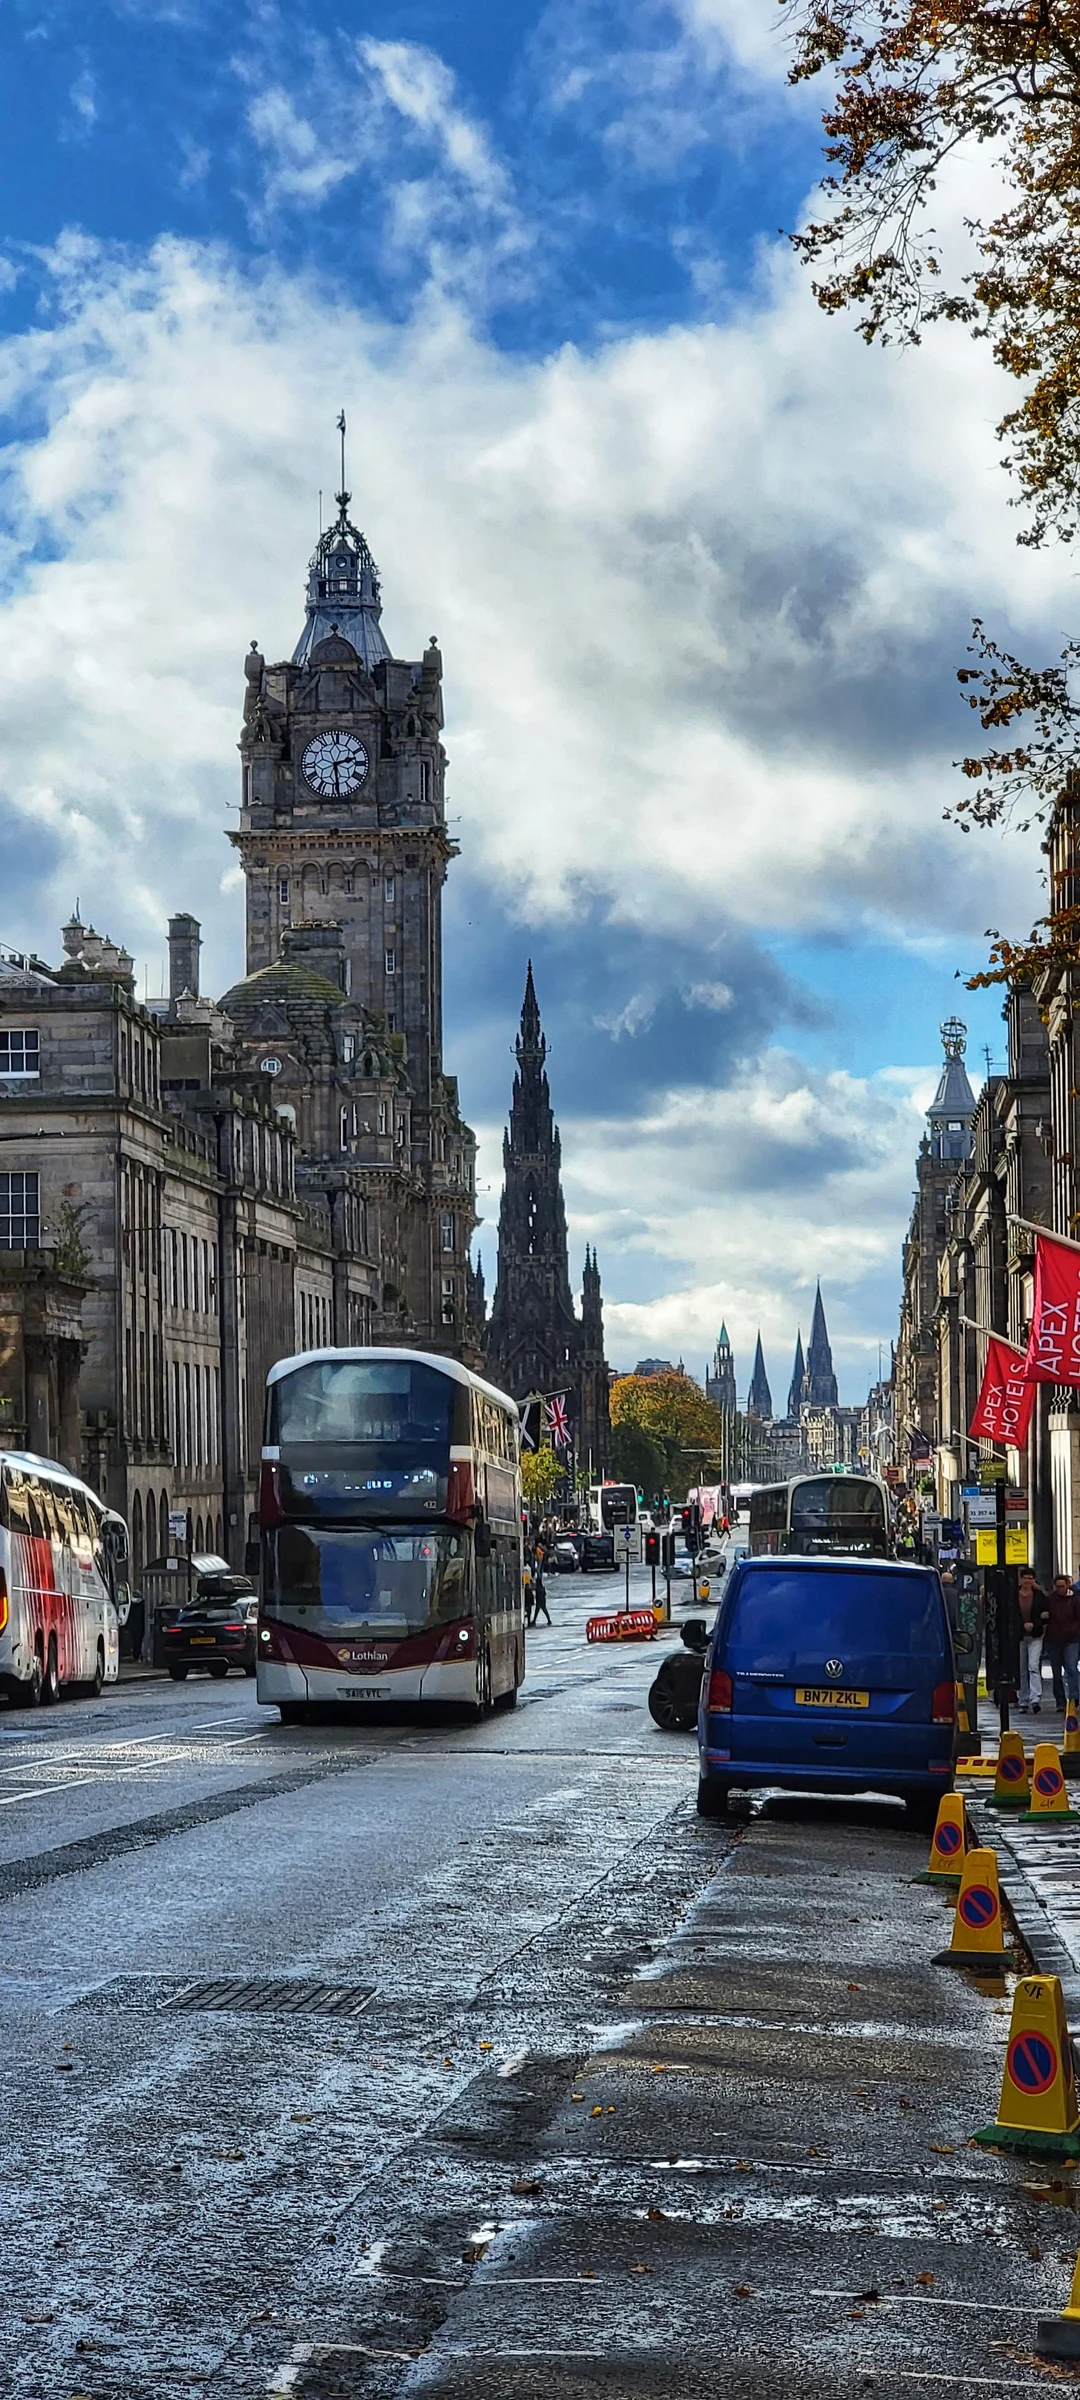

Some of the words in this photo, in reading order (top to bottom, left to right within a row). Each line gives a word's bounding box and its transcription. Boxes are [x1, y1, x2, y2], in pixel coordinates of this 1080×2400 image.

[1035, 1300, 1069, 1376] APEX
[980, 1382, 1004, 1434] APEX
[963, 1574, 973, 1589] P
[352, 1650, 388, 1661] Lothian
[803, 1690, 833, 1703] BN71
[836, 1691, 862, 1705] ZKL
